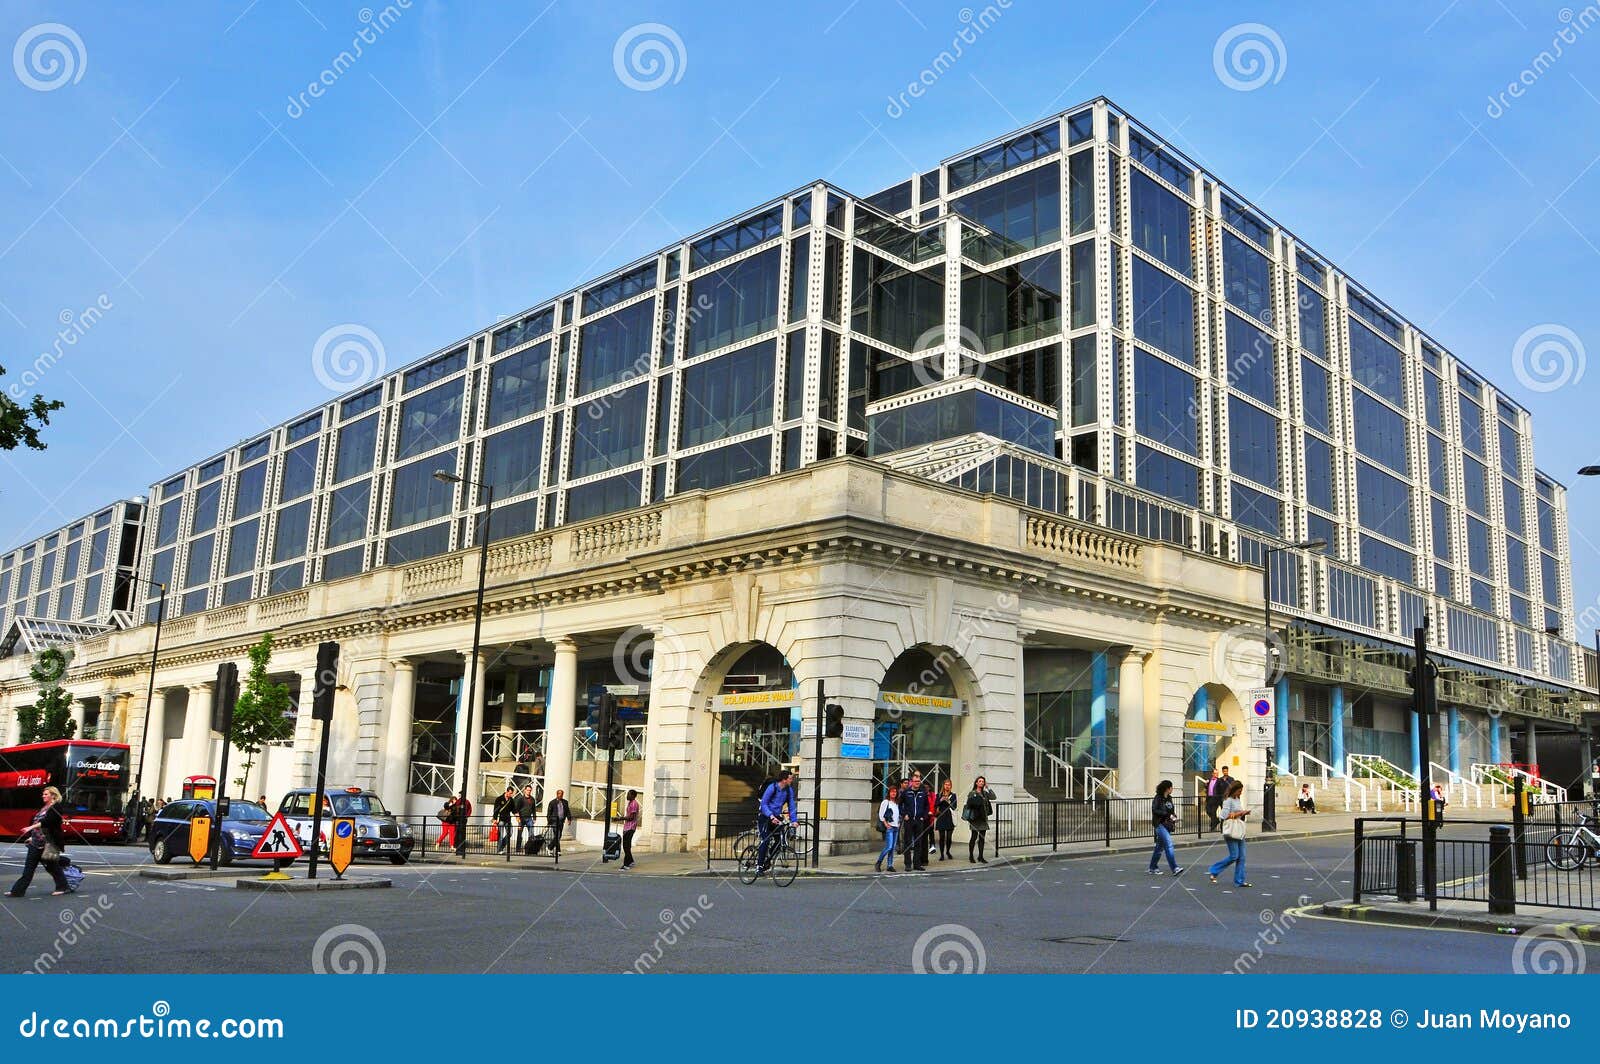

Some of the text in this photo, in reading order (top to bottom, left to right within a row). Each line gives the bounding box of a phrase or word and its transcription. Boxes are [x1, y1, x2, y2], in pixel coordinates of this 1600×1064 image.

[723, 691, 795, 705] COLONNADE WALK
[932, 697, 953, 708] WALK
[77, 761, 120, 771] Oxford tube
